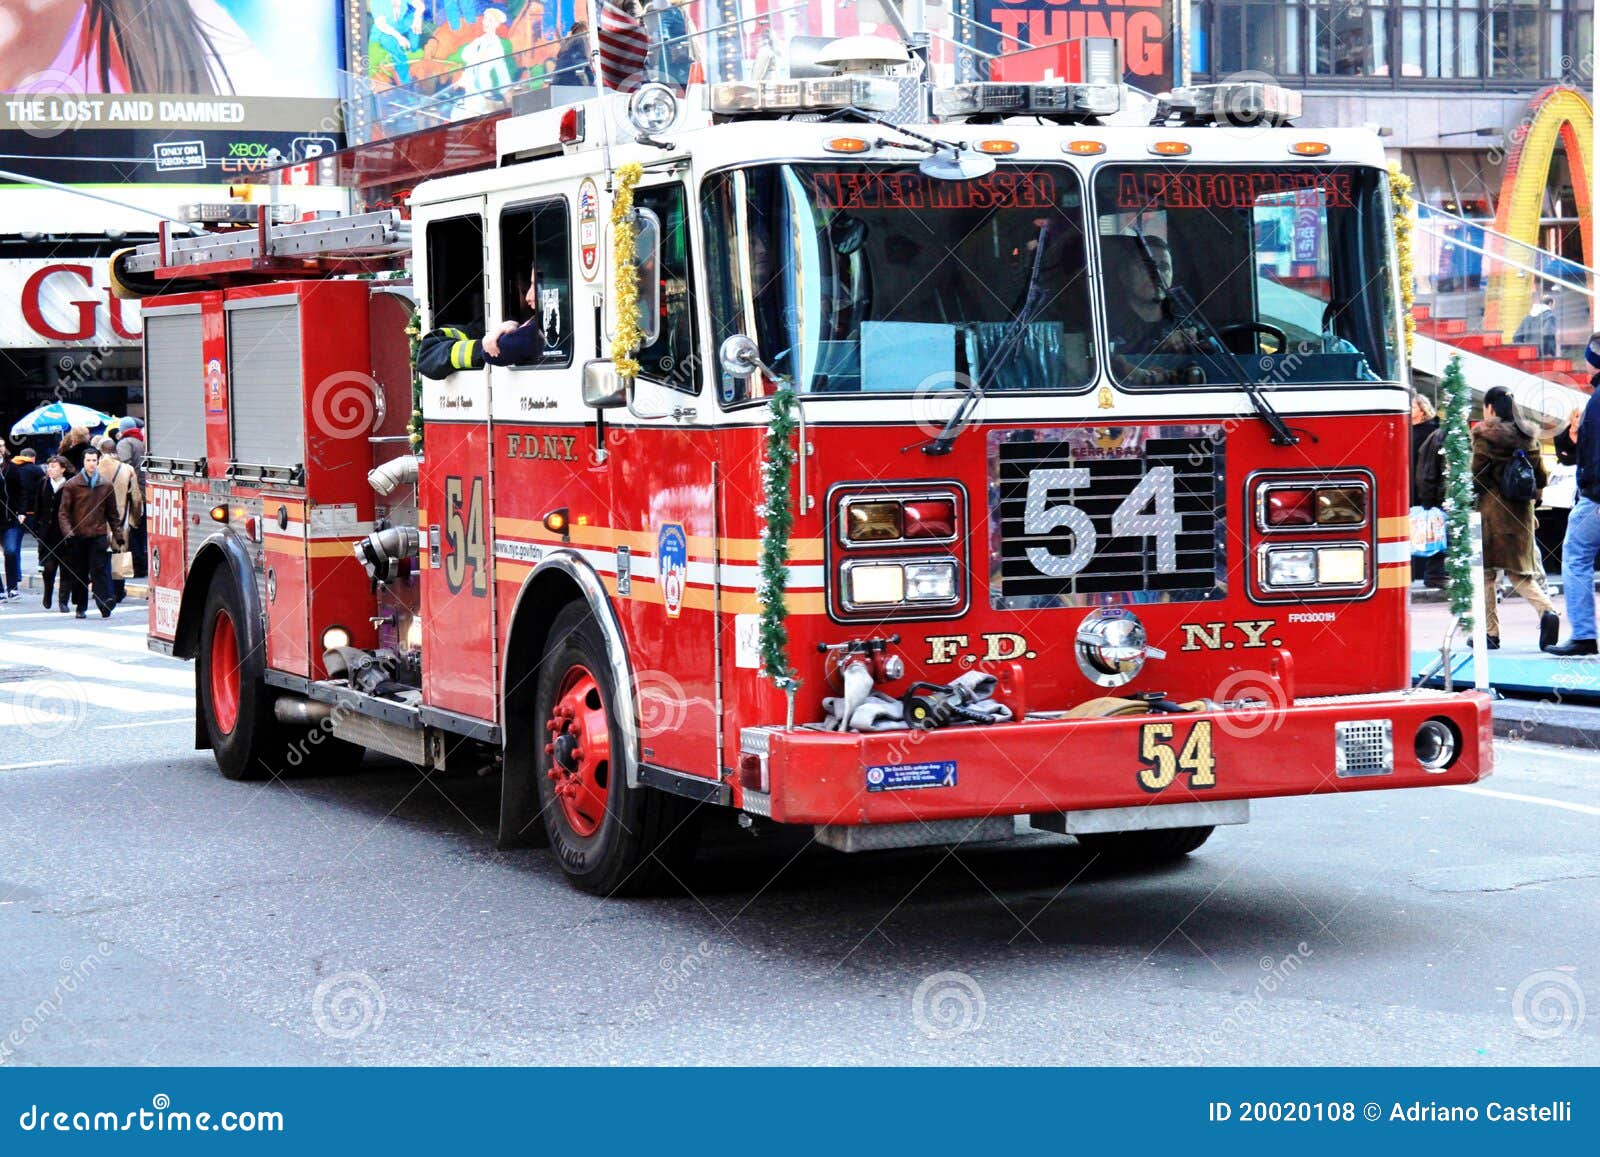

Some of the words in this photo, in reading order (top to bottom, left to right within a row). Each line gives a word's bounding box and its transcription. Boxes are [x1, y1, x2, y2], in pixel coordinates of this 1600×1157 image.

[6, 101, 46, 121] THE
[50, 101, 104, 121] LOST
[108, 101, 154, 122] AND
[159, 102, 245, 123] DAMNED
[160, 146, 182, 157] ONLY
[183, 145, 199, 156] ON
[228, 142, 268, 157] XBOX
[813, 173, 924, 208] NEVER
[928, 172, 1056, 208] MISSED
[1119, 173, 1141, 208] A
[1144, 173, 1350, 208] PERFORMANCE
[507, 434, 579, 461] F.D.N.Y.
[152, 488, 180, 538] FIRE
[1024, 466, 1182, 576] 54
[445, 476, 488, 597] 54
[925, 633, 1037, 664] F.D.
[1181, 620, 1283, 651] N.Y.
[1136, 720, 1217, 794] 54
